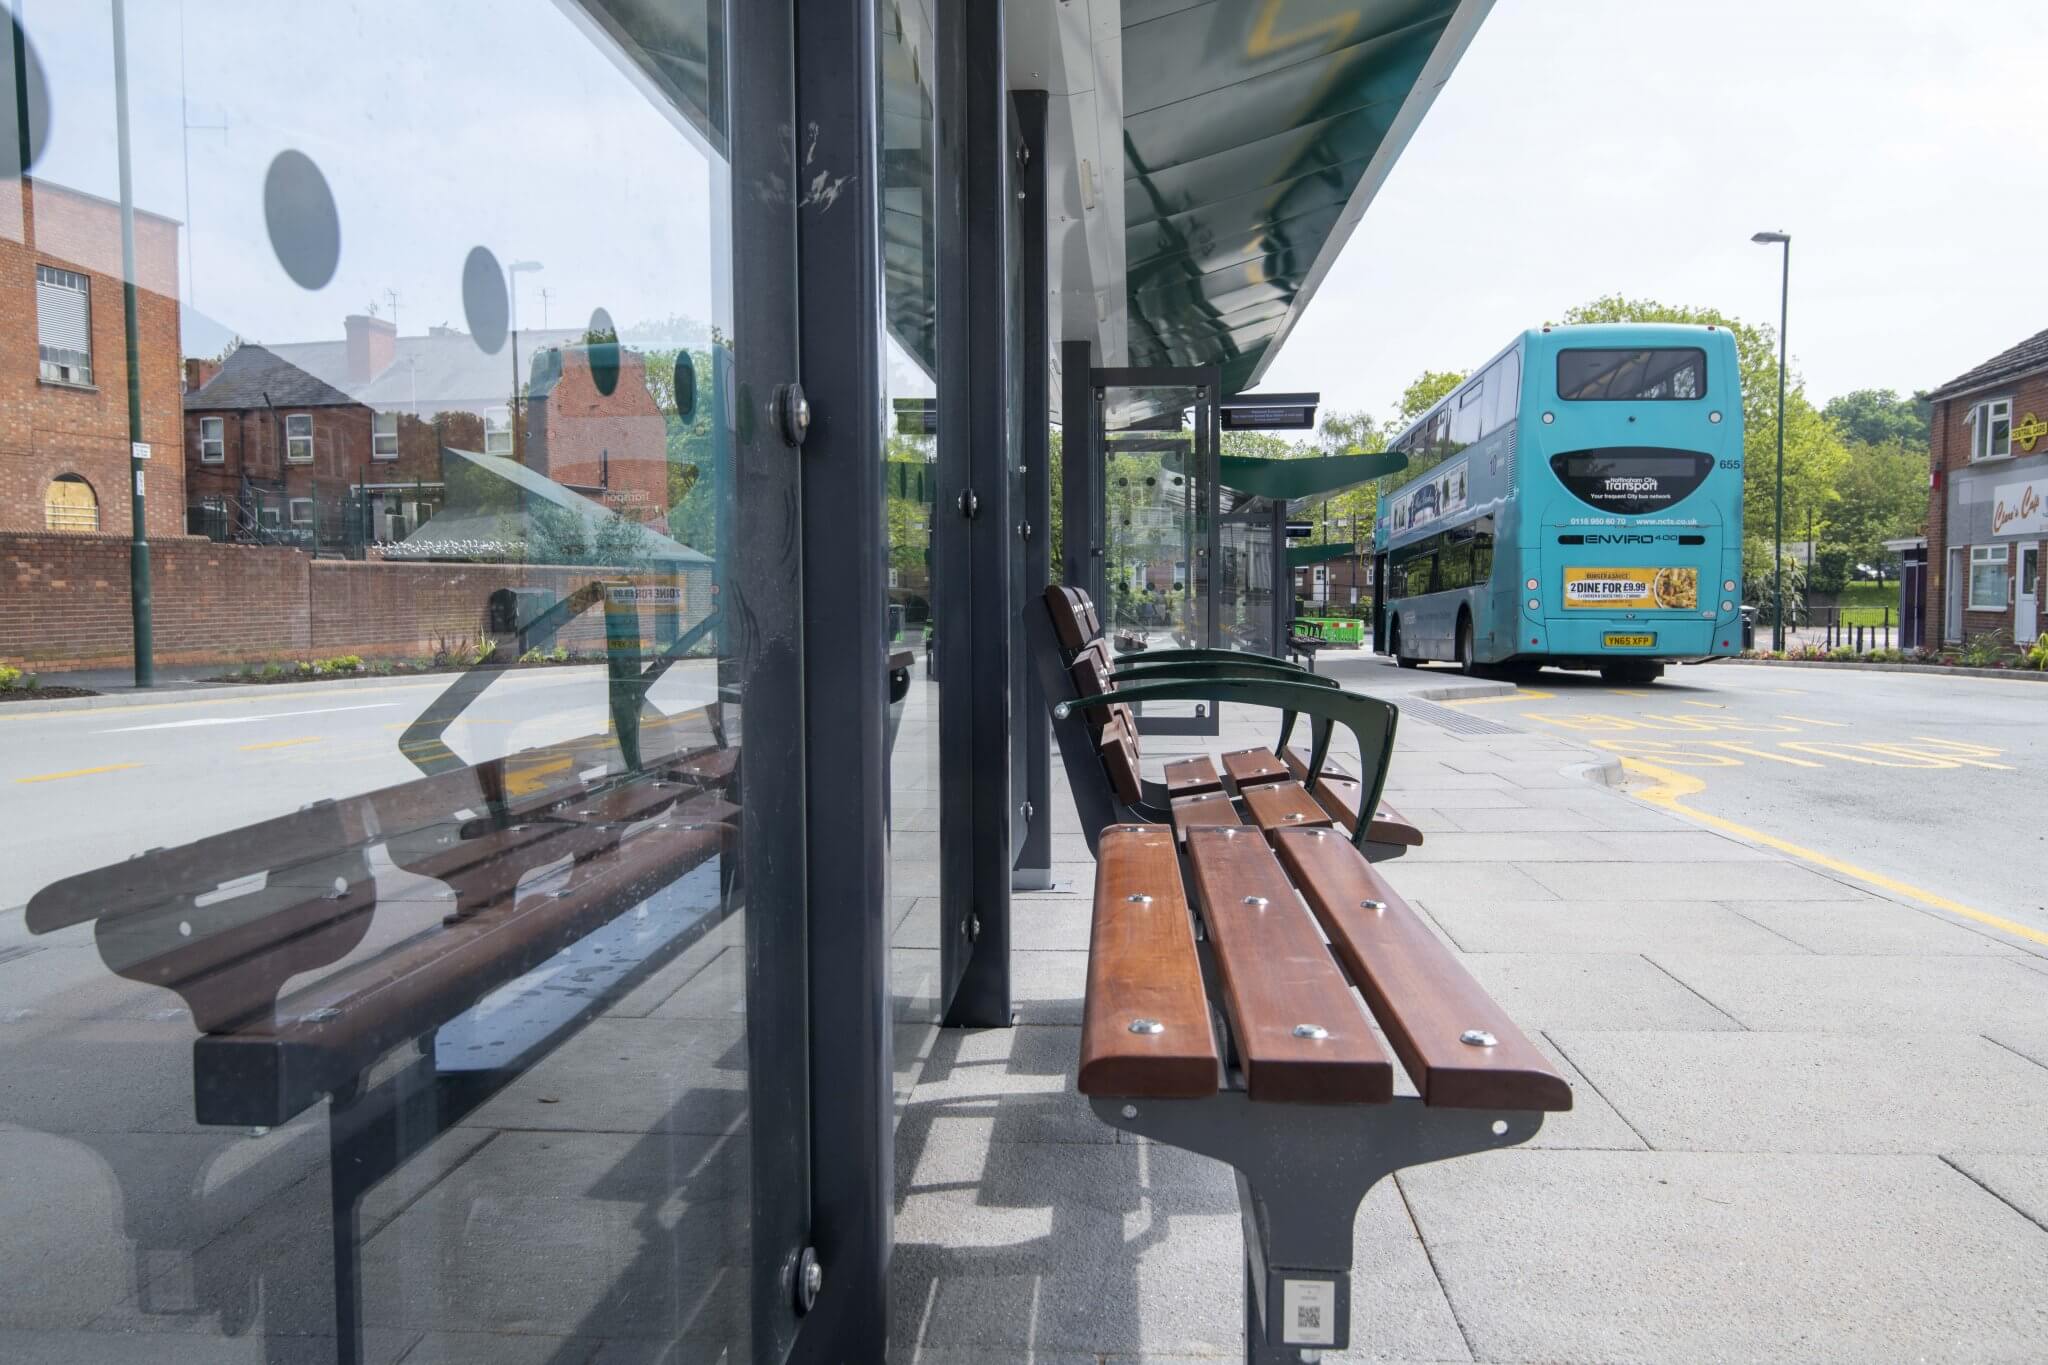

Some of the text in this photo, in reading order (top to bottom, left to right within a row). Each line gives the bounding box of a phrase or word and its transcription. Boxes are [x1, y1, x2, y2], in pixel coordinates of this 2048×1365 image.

[1719, 459, 1741, 470] 655
[1605, 479, 1658, 493] Transport
[1585, 534, 1654, 544] ENVIRO
[1570, 582, 1646, 593] 2 DINE FOR £9.99
[1608, 636, 1649, 645] YN65 XFP
